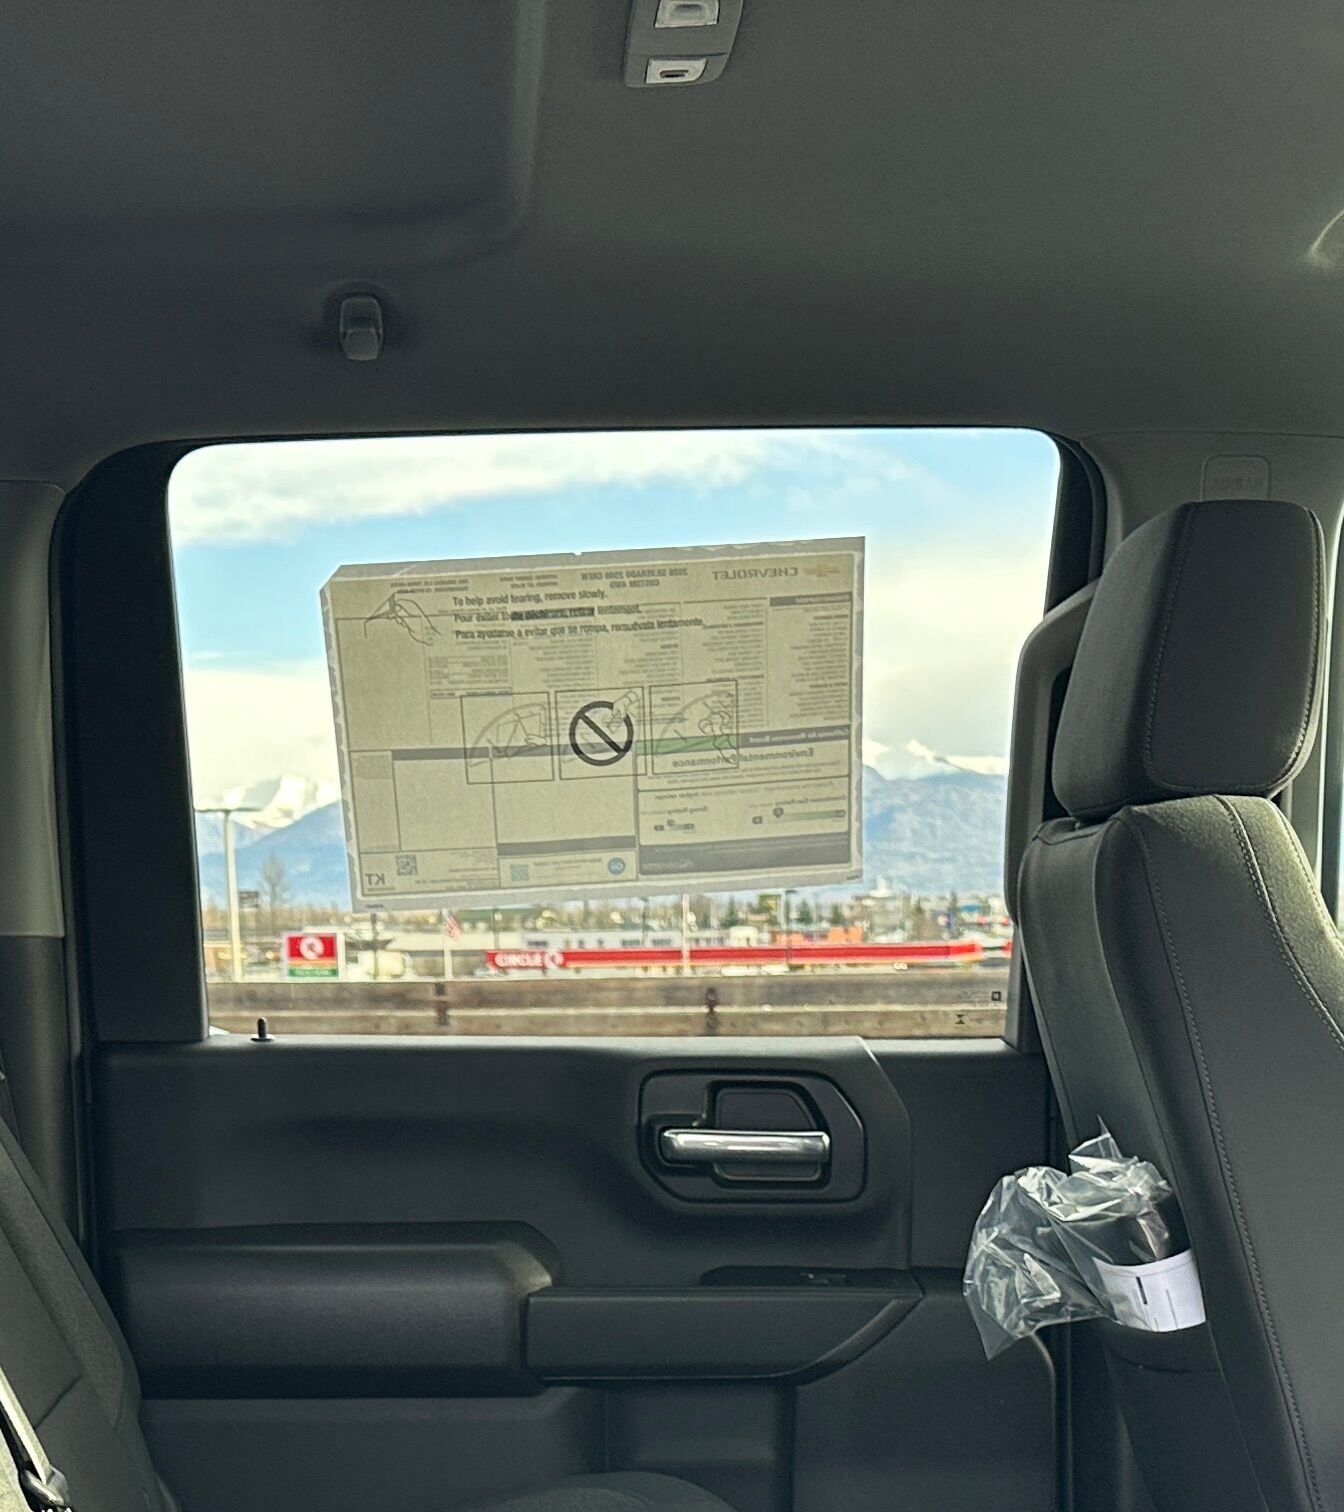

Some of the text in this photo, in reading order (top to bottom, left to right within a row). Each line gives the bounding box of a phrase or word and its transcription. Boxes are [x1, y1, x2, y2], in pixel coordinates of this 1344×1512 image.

[453, 588, 608, 608] To help avoid tearing, remove slowly.
[454, 612, 473, 623] Pour
[455, 629, 475, 640] Para
[524, 626, 548, 638] evitar
[550, 626, 565, 638] que
[567, 625, 578, 635] se
[580, 623, 609, 635] rompa,
[494, 952, 544, 968] CIRCLE
